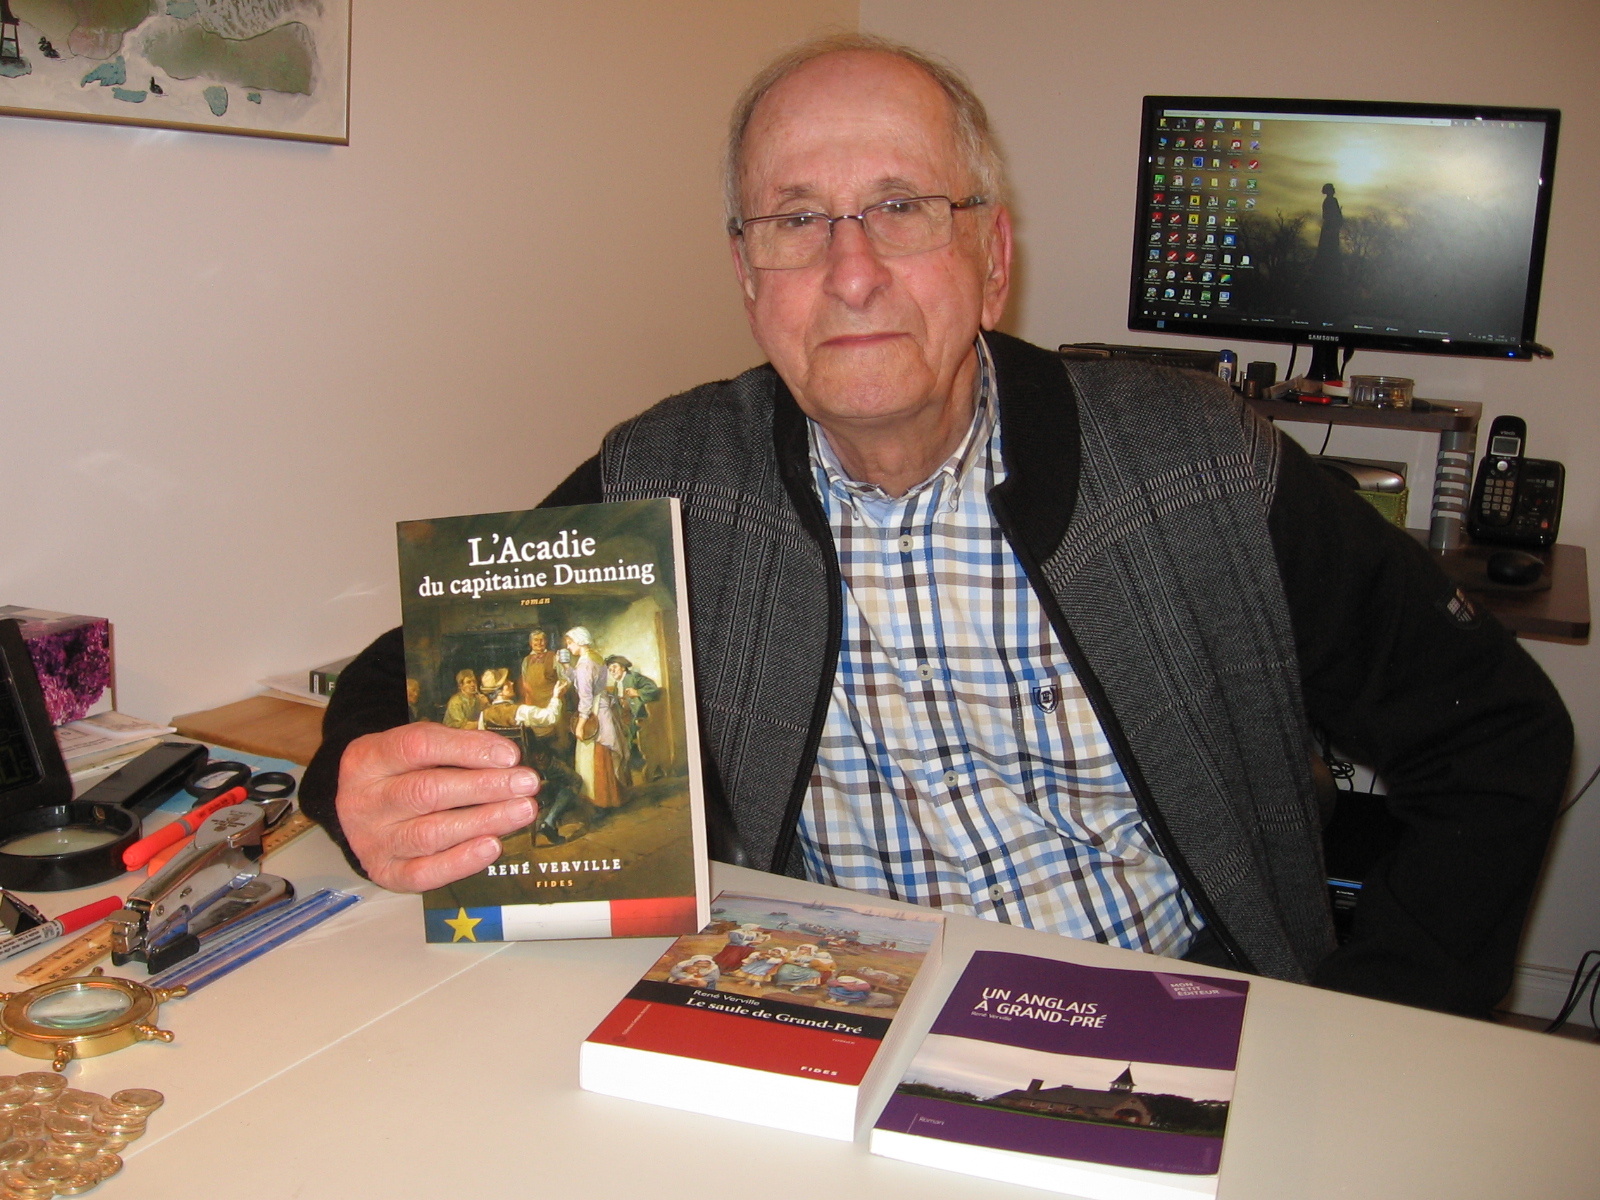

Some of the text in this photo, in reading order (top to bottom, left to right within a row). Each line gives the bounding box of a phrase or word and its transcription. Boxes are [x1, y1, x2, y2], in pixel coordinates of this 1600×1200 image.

[1308, 334, 1339, 342] SAMSUNG
[467, 529, 596, 567] L'Acadie
[418, 559, 655, 599] du capitaine Dunning
[520, 597, 551, 606] roman
[487, 858, 622, 876] RENÉ VERVILLE
[536, 879, 574, 888] FIDES
[692, 989, 760, 1006] René Verville
[982, 987, 1099, 1015] UN ANGLAIS
[1177, 989, 1221, 997] ÉDITEUR
[686, 997, 863, 1035] Le saule de Grand-Pré
[974, 996, 1107, 1029] À GRAND-PRÉ
[800, 1065, 838, 1076] FIDES
